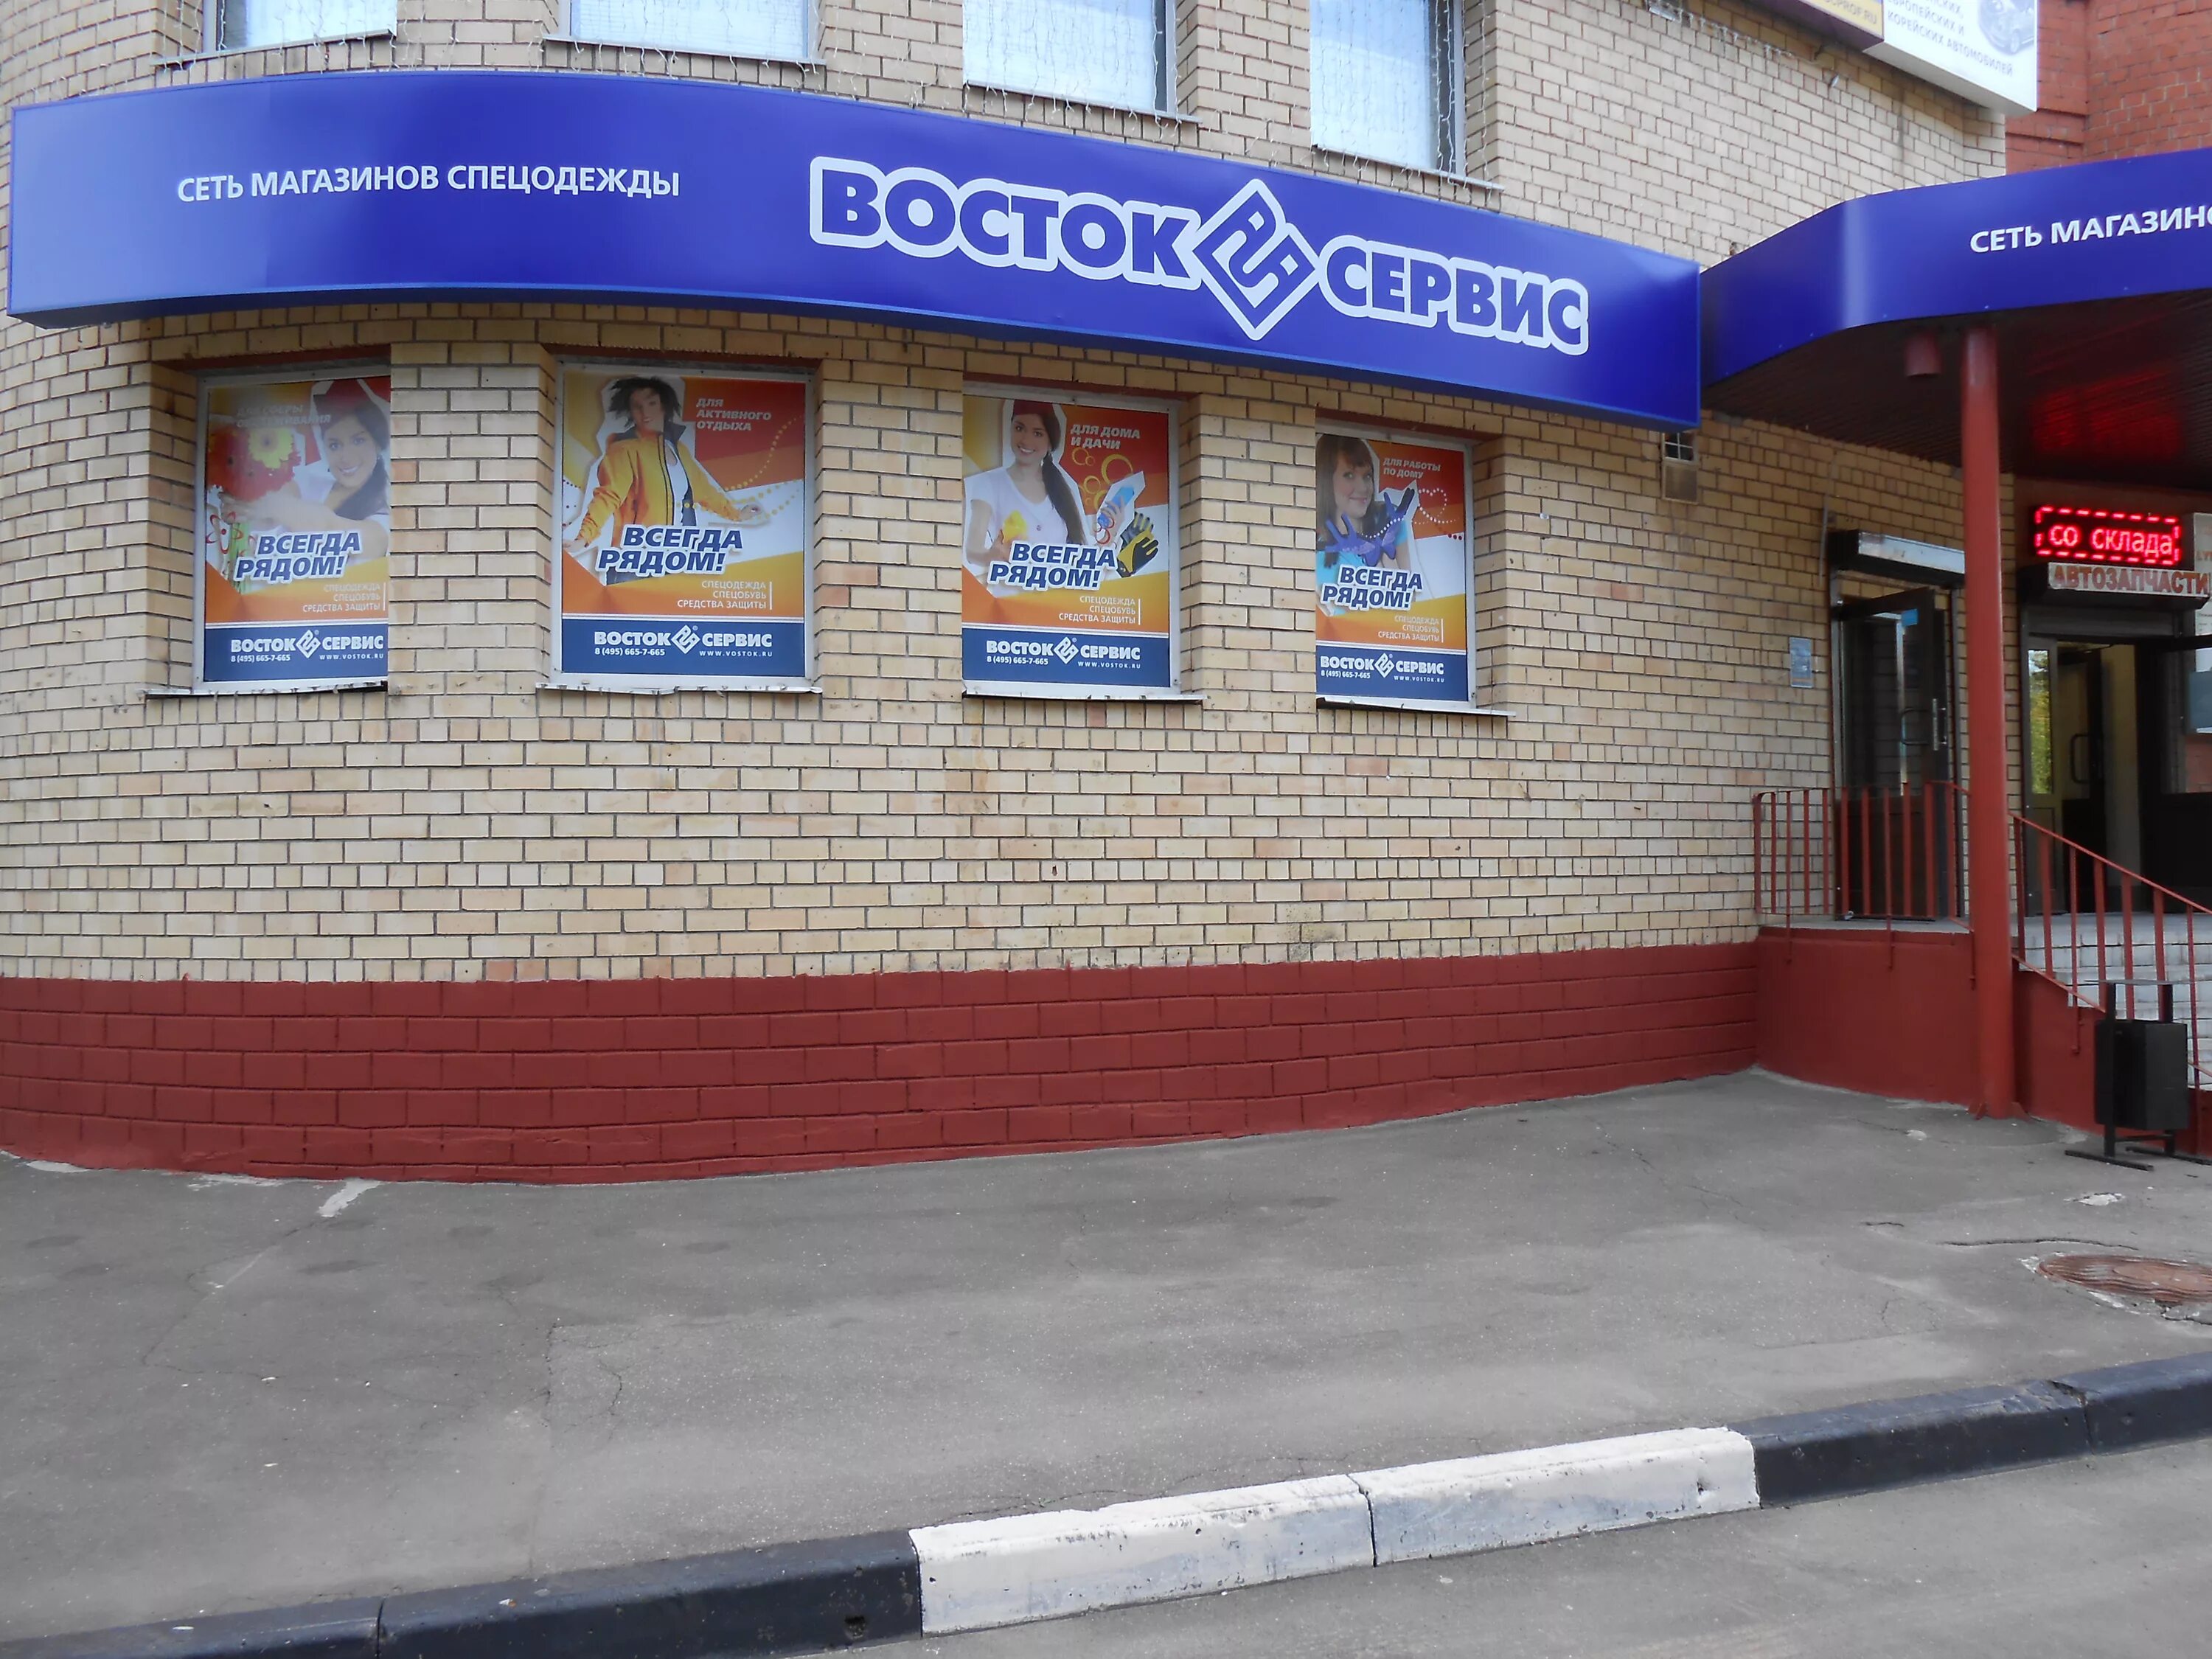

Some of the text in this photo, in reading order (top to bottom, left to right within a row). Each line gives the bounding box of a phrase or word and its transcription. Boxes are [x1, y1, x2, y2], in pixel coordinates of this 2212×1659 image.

[1888, 0, 1955, 32] ВРОПЕЙСКИХ
[1888, 10, 2014, 77] КОРЕЙСКИХ АВТОМОБИЛЕЙ
[177, 164, 680, 203] СЕТЬ МАГАЗИНОВ СПЕЦОДЕЖДЫ
[1969, 226, 2042, 254] СЕТЬ
[810, 156, 1590, 355] ВОСТОК СЕРВИС
[696, 398, 723, 408] ДЛЯ
[696, 410, 772, 420] АКТИВНОГО
[697, 421, 752, 431] ОТДЫХА
[1070, 424, 1141, 439] ДЛЯ ДОМА
[1071, 437, 1121, 450] И ДАЧИ
[1383, 458, 1441, 472] ДЛЯ РАБОТЫ
[1383, 467, 1424, 479] ПО ДОМУ
[257, 532, 361, 557] ВСЕГДА
[623, 526, 743, 550] ВСЕГДА
[2091, 528, 2174, 558] склада
[598, 550, 725, 574] РЯДОМ!
[1012, 542, 1118, 570] ВСЕГДА
[236, 554, 345, 582] РЯДОМ!
[990, 564, 1101, 590] РЯДОМ!
[1339, 566, 1423, 591] ВСЕГДА
[2053, 566, 2210, 594] АВТОЗАПЧАСТИ
[701, 580, 767, 591] СПЕЦОДЕЖДА
[712, 591, 768, 599] СПЕЦОБУВЬ
[1079, 595, 1136, 606] СПЕЦОДЕЖДА
[1322, 585, 1411, 609] РЯДОМ!
[677, 599, 767, 609] СРЕДСТВА ЗАЩИТЫ
[1089, 605, 1136, 616] СПЕЦОБУВЬ
[1059, 613, 1136, 625] СРЕДСТВА ЗАЩИТЫ
[594, 631, 773, 647] ВОСТОК СЕРВИС
[1377, 630, 1440, 642] СРЕДСТВА ЗАЩИТЫ
[231, 636, 384, 653] ВОСТОК СЕРВИС
[602, 648, 623, 656] (495)
[986, 640, 1141, 661] ВОСТОК СЕРВИС
[237, 655, 255, 664] (495)
[256, 654, 291, 662] 665-7-665
[993, 656, 1012, 664] (495)
[1013, 656, 1048, 665] 665-7-665
[1077, 661, 1141, 669] WWW.VOSTOK.RU
[1320, 655, 1444, 675] ВОСТОК СЕРВИС
[1326, 670, 1341, 678] (495)
[1342, 671, 1371, 679] 665-7-665
[1394, 675, 1444, 684] WWW.VOSTOK.RU
